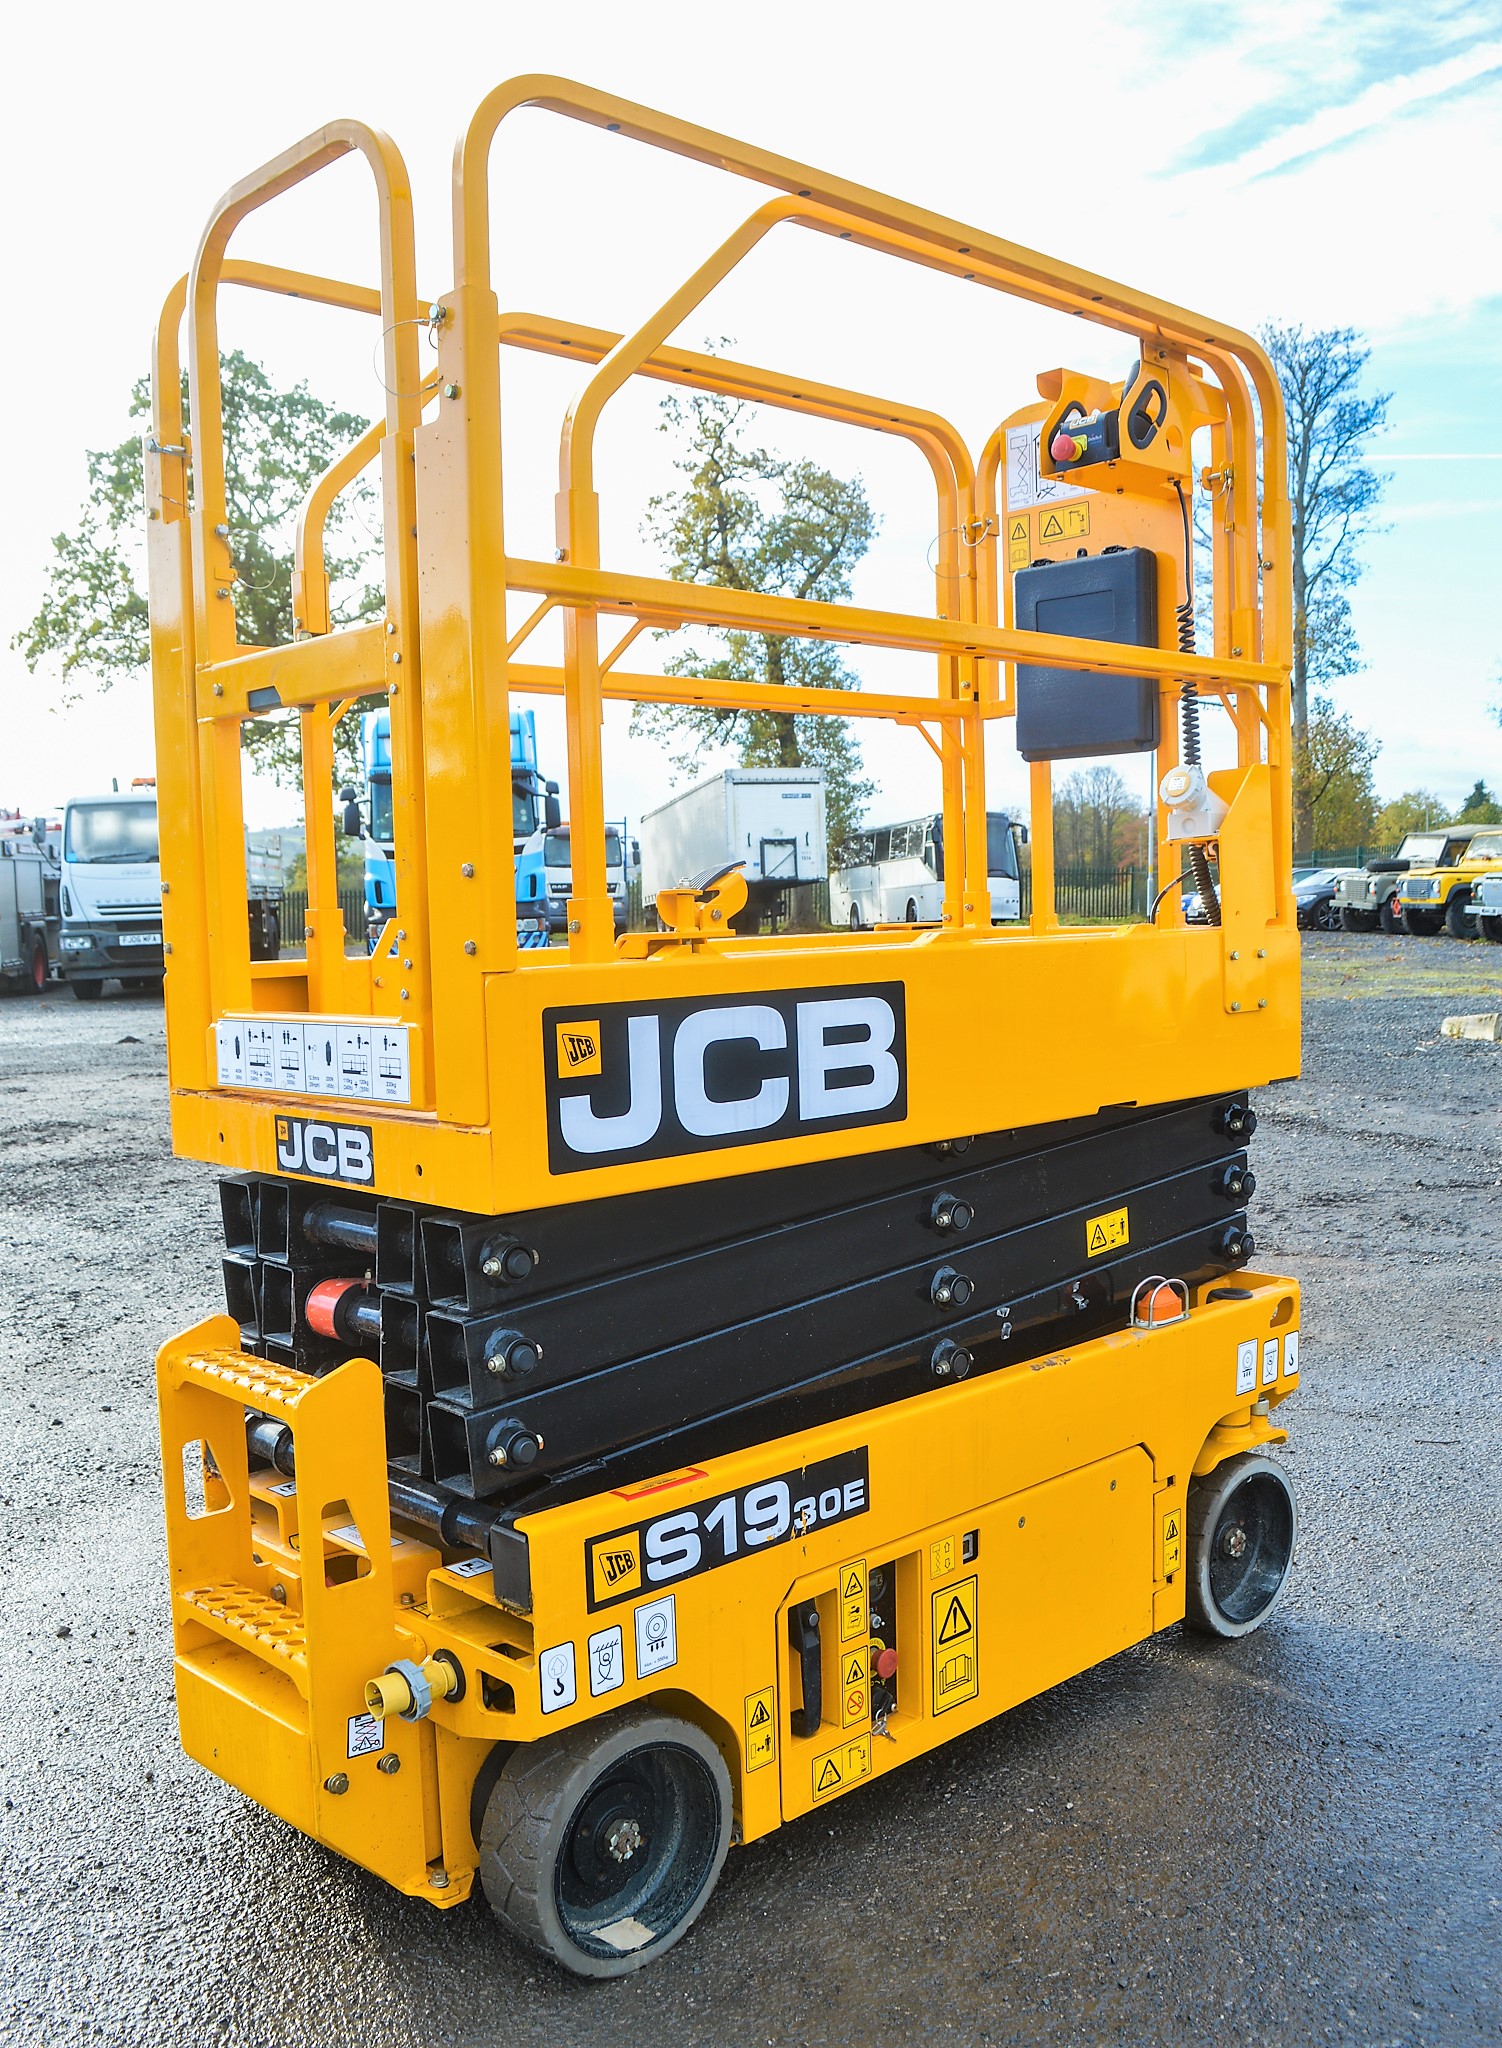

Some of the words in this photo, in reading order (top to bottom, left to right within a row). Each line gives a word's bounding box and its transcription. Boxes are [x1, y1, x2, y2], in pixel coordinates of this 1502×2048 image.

[568, 1037, 595, 1059] JCB
[559, 996, 900, 1154] JCB
[278, 1121, 373, 1181] JCB
[606, 1551, 634, 1581] JCB
